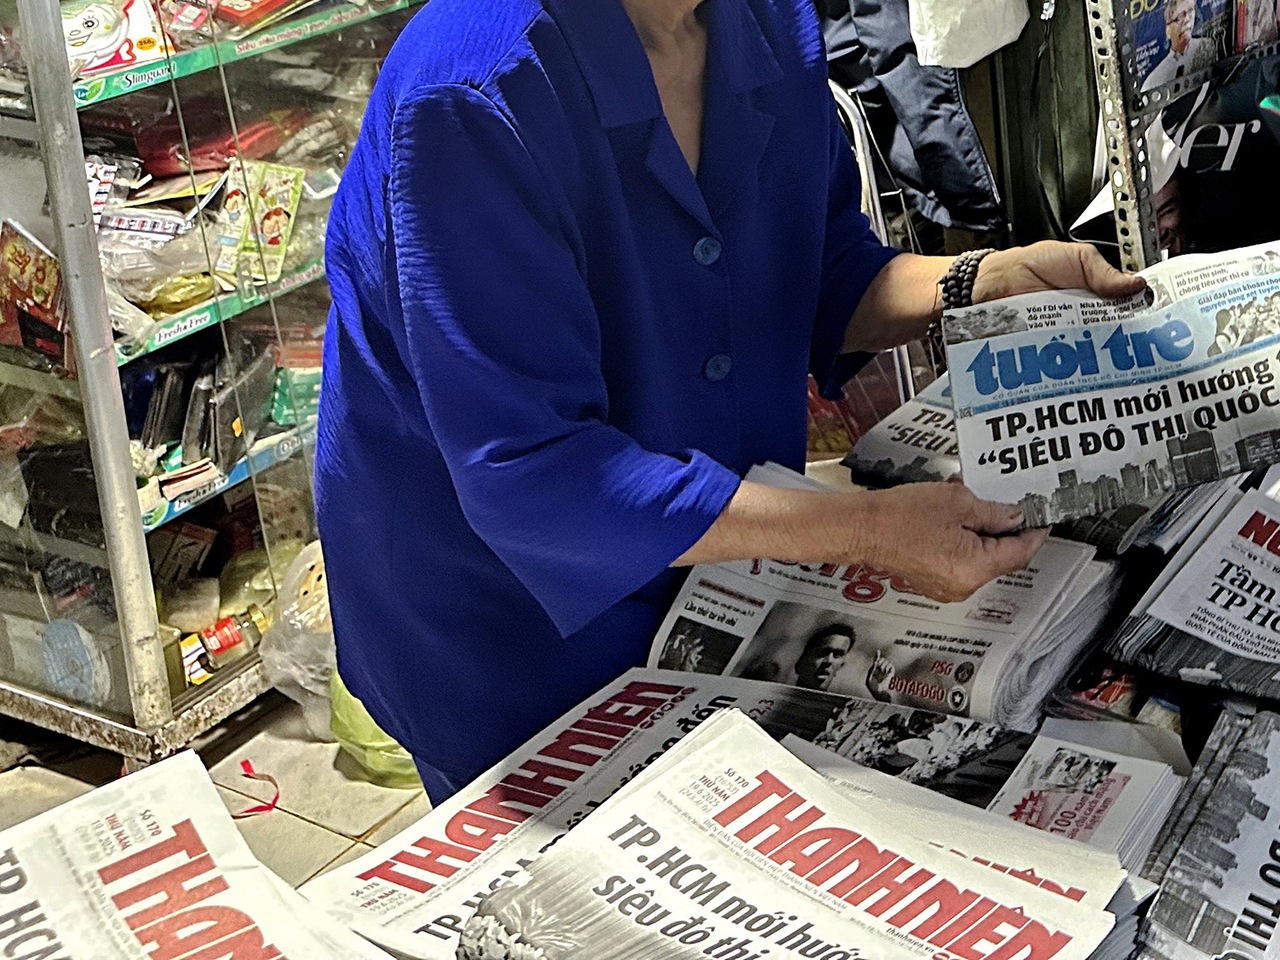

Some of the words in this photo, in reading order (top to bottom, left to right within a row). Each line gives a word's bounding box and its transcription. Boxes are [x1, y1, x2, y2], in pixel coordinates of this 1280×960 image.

[123, 61, 177, 89] Slimguard
[1179, 284, 1200, 296] chống
[1201, 279, 1215, 288] tiêu
[1229, 272, 1240, 281] thi
[1188, 277, 1198, 285] trợ
[1199, 272, 1210, 281] thi
[1211, 269, 1228, 278] sinh,
[1198, 295, 1212, 305] Giải
[1213, 292, 1227, 304] đáp
[1243, 281, 1266, 292] khoăn
[1044, 304, 1056, 312] FDI
[1081, 308, 1108, 316] trường
[1082, 317, 1100, 325] giữa
[1028, 321, 1044, 329] vào
[966, 322, 1101, 397] tuổi
[1101, 312, 1196, 372] trẻ
[986, 394, 1107, 442] TP.HCM
[1116, 382, 1172, 416] mới
[1179, 360, 1274, 403] hướng
[978, 429, 1072, 475] “SIÊU
[1078, 424, 1126, 456] ĐÔ
[1131, 410, 1188, 445] THỊ
[1193, 384, 1280, 431] QUỐC
[1214, 557, 1276, 604] Tầm
[1206, 581, 1248, 613] TP
[930, 661, 953, 676] PSG
[888, 677, 946, 702] BOTAFOGO
[699, 774, 713, 789] THỨ
[712, 785, 730, 802] NĂM
[724, 767, 735, 779] Số
[737, 775, 750, 788] 170
[355, 759, 586, 894] THANH
[1051, 810, 1077, 833] 100
[607, 813, 733, 907] TP.HCM
[711, 895, 799, 939] mới
[712, 769, 937, 917] THANH
[886, 877, 1073, 960] NIÊN
[593, 872, 673, 929] siêu
[659, 914, 716, 946] đô
